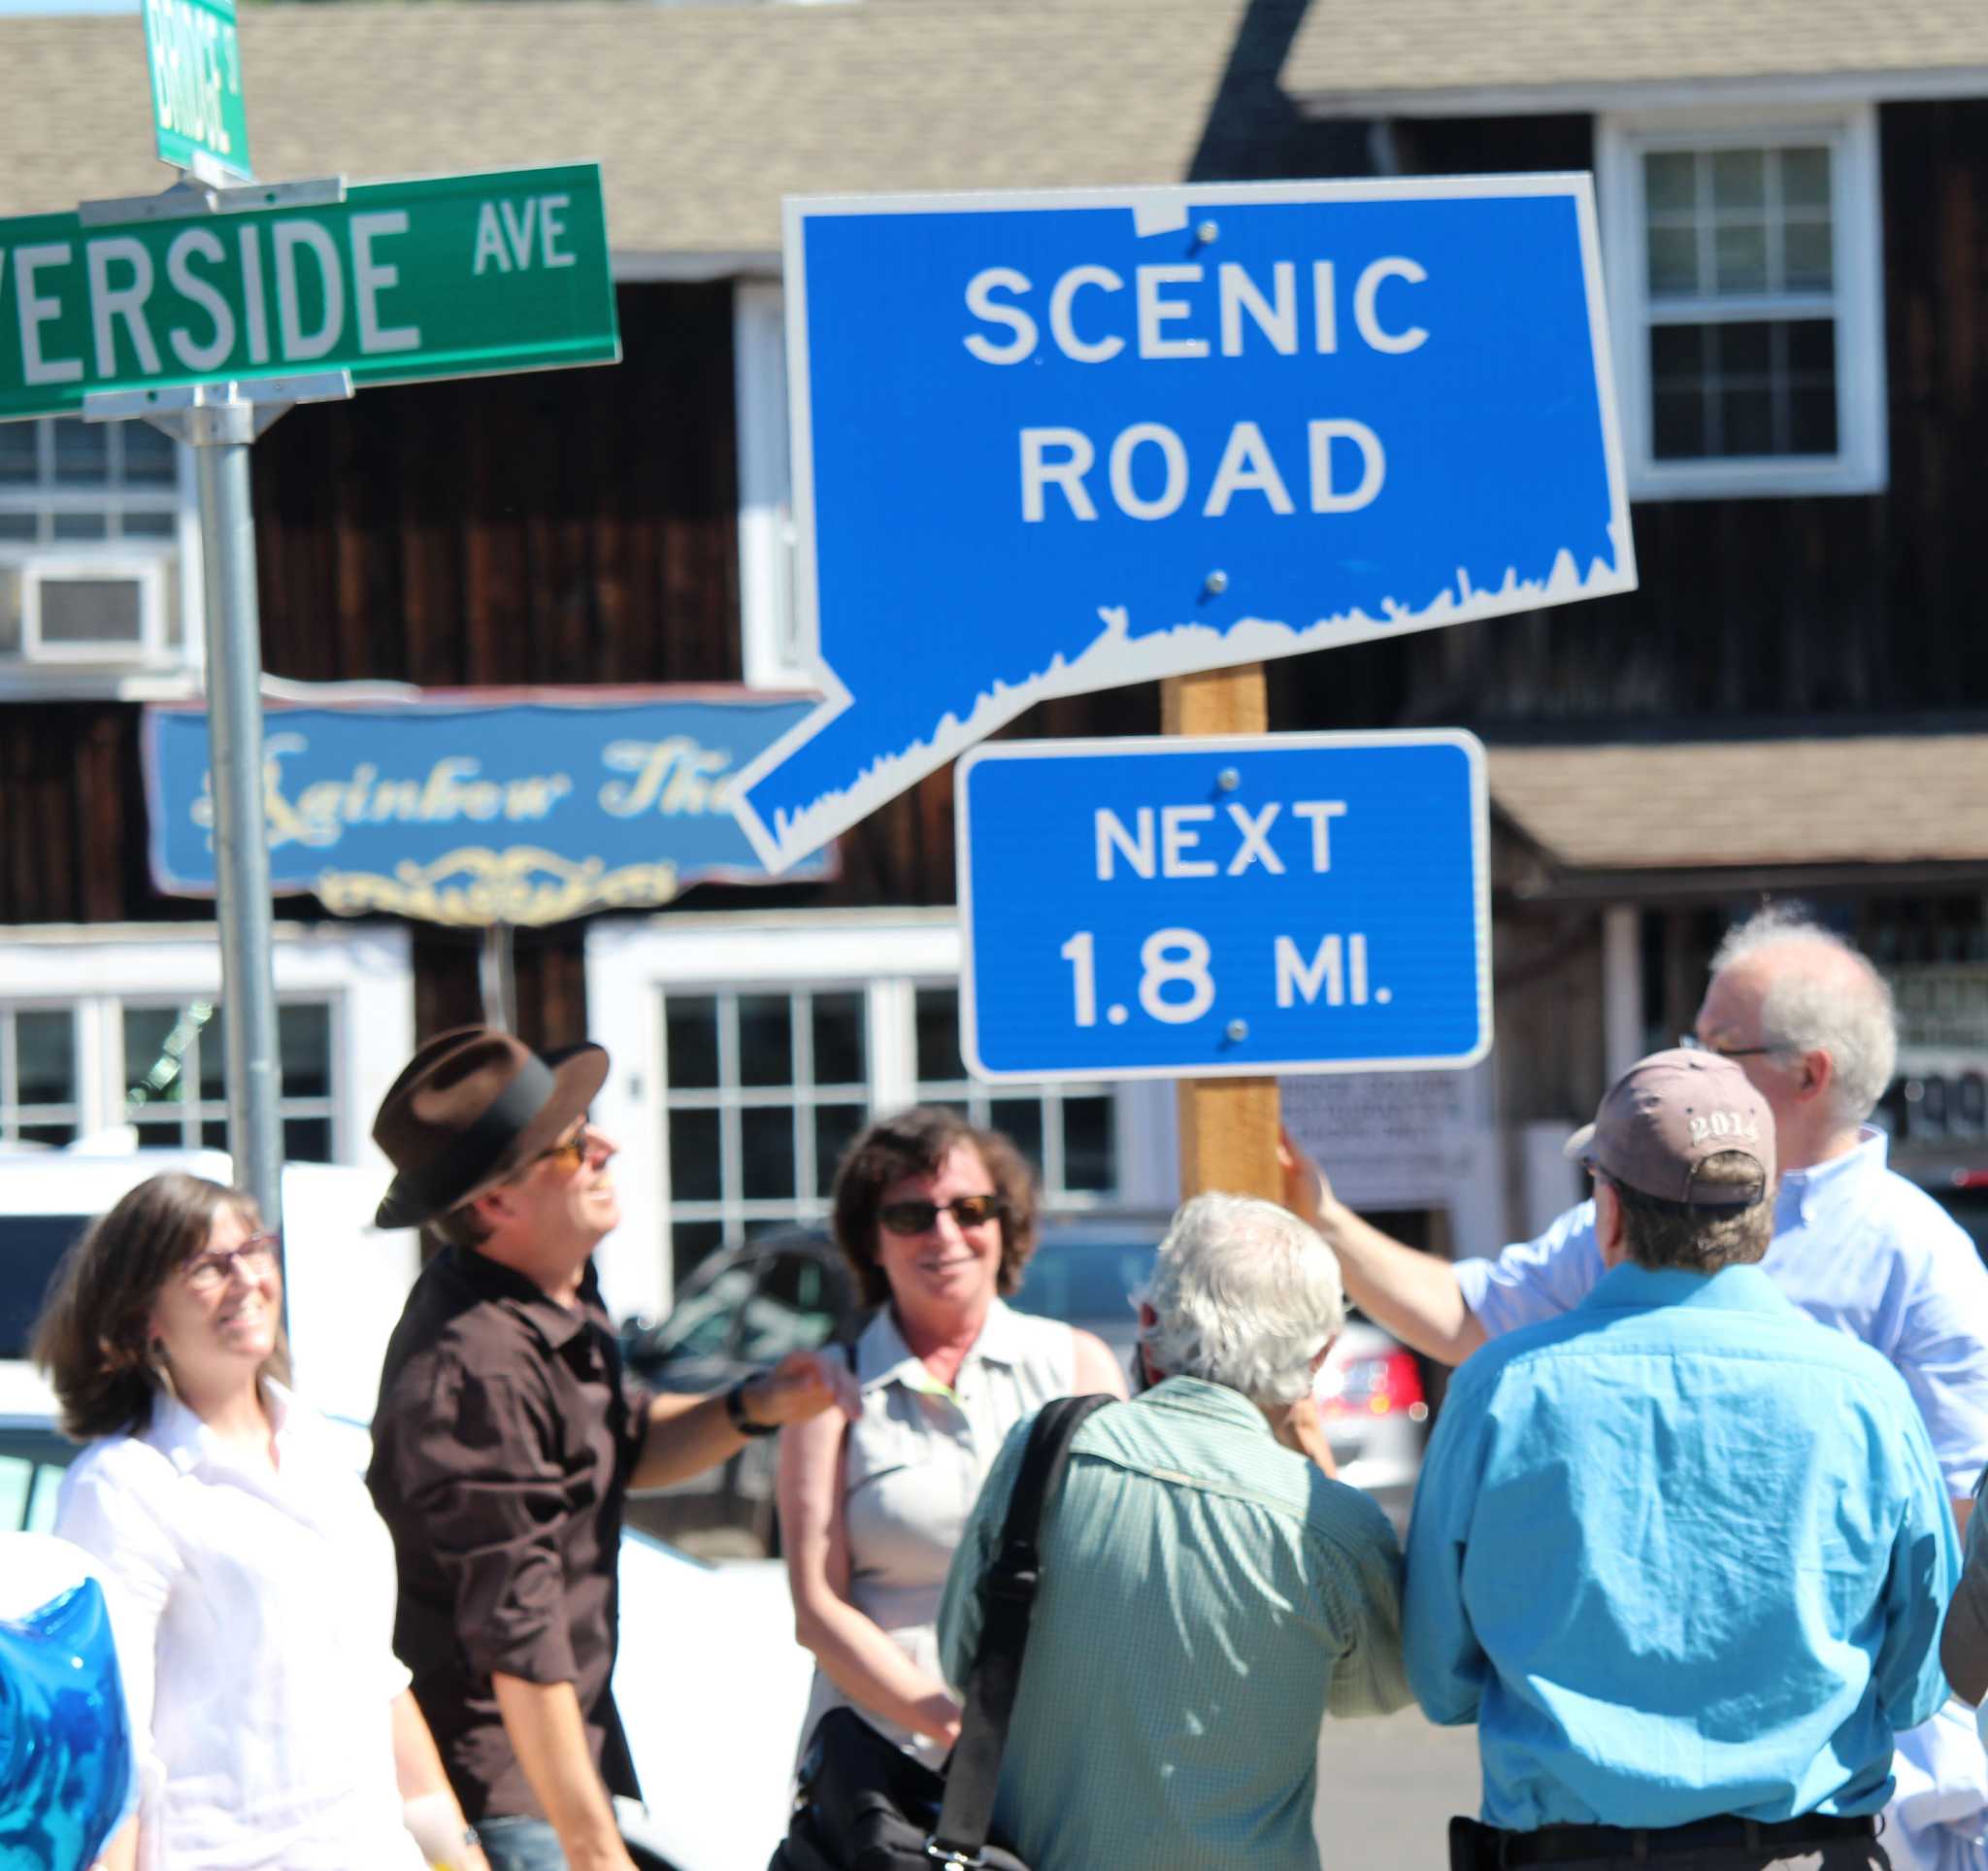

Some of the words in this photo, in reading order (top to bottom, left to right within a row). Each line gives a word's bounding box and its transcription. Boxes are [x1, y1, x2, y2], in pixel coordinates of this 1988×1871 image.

[0, 211, 421, 385] ERSIDE
[473, 195, 577, 276] AVE
[963, 256, 1430, 365] SCENIC
[1019, 418, 1386, 522] ROAD
[1094, 800, 1347, 881] NEXT
[1061, 927, 1215, 1027] 1.8
[1275, 932, 1392, 1009] MI.
